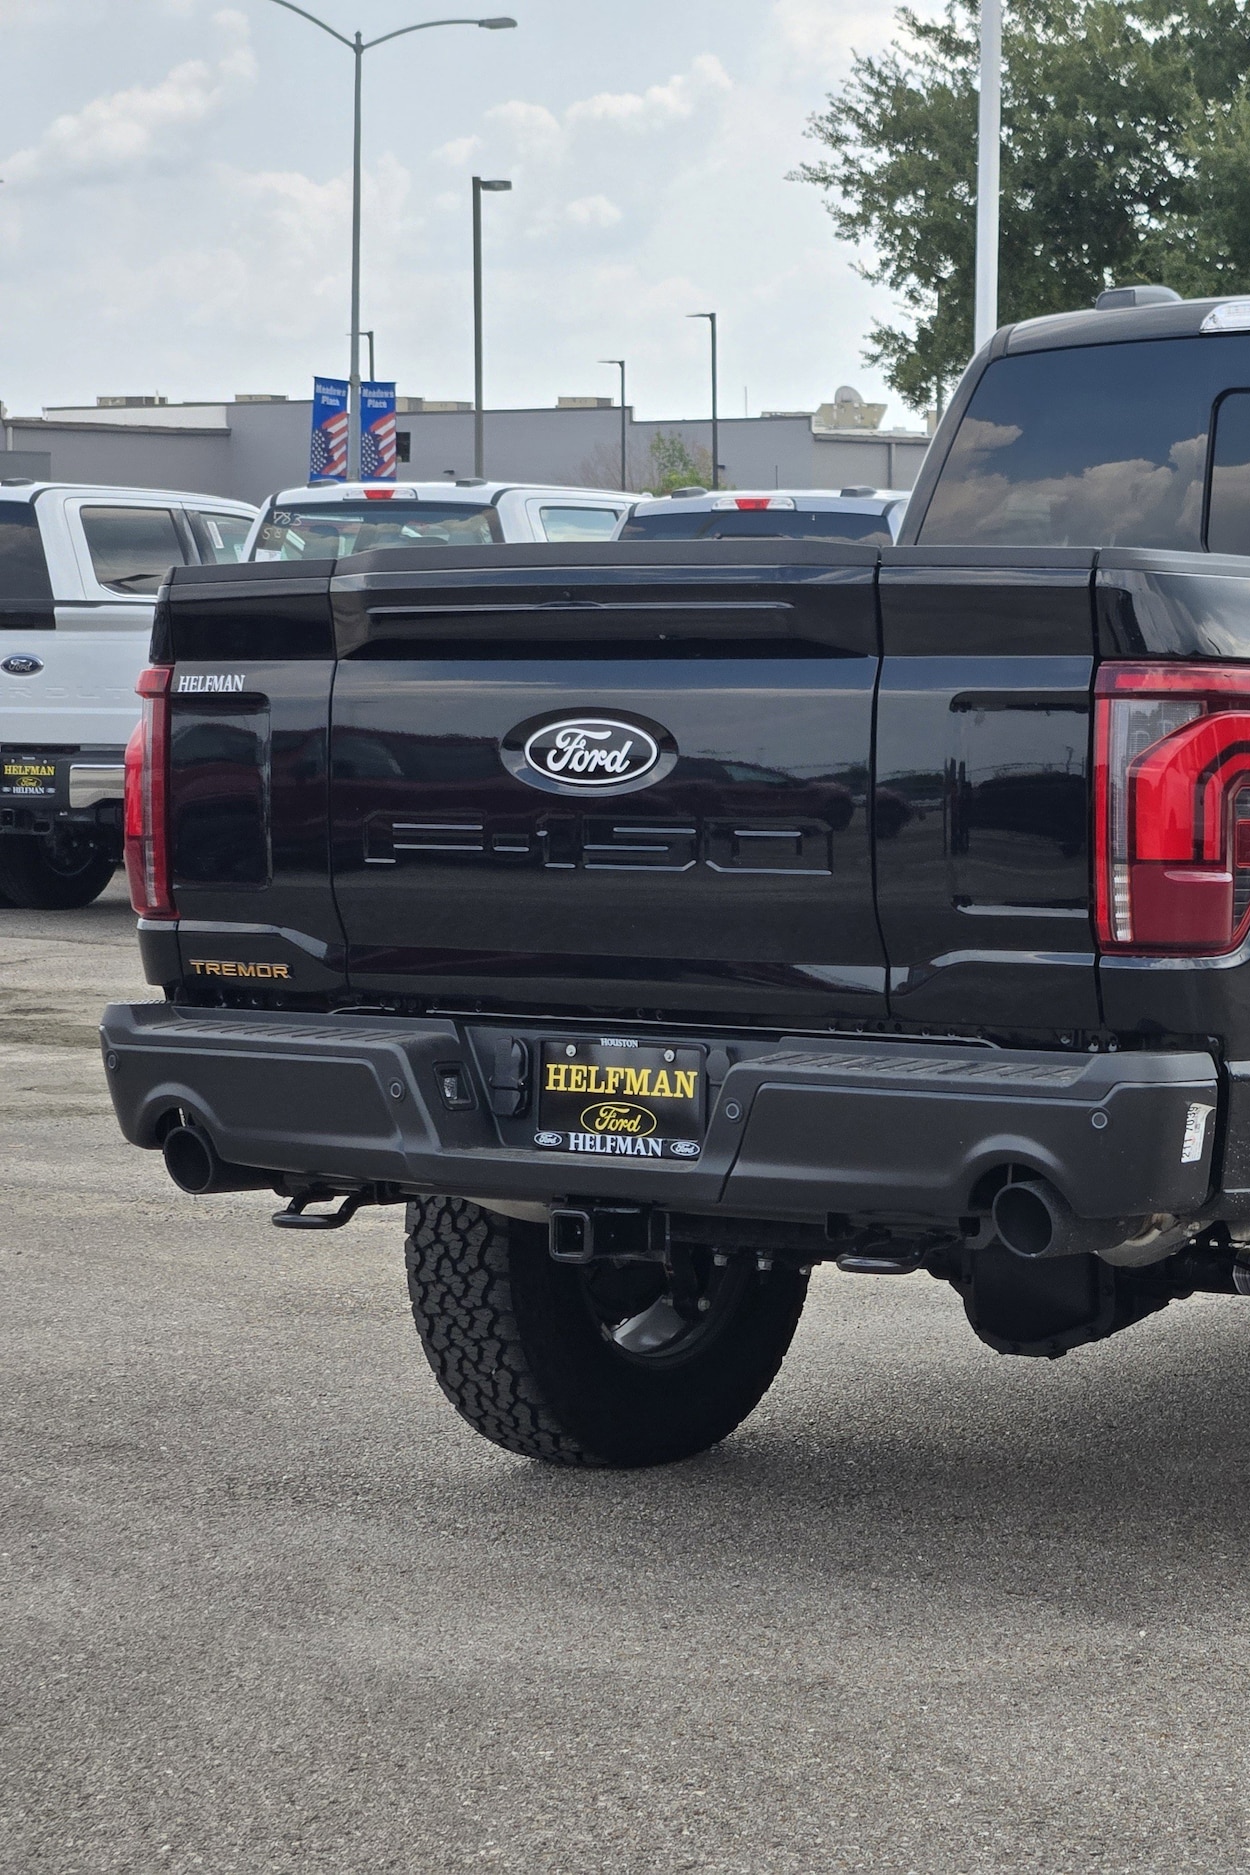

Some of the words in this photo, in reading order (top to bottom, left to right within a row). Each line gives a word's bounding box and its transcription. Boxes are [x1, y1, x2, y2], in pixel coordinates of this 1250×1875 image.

[177, 674, 246, 693] HELFMAN
[546, 727, 634, 773] Ford
[4, 764, 55, 776] HELFMAN
[189, 959, 292, 979] TREMOR
[600, 1037, 638, 1048] HOUSTON
[545, 1063, 698, 1099] HELFMAN
[594, 1105, 642, 1133] Ford
[568, 1132, 663, 1157] HELFMAN
